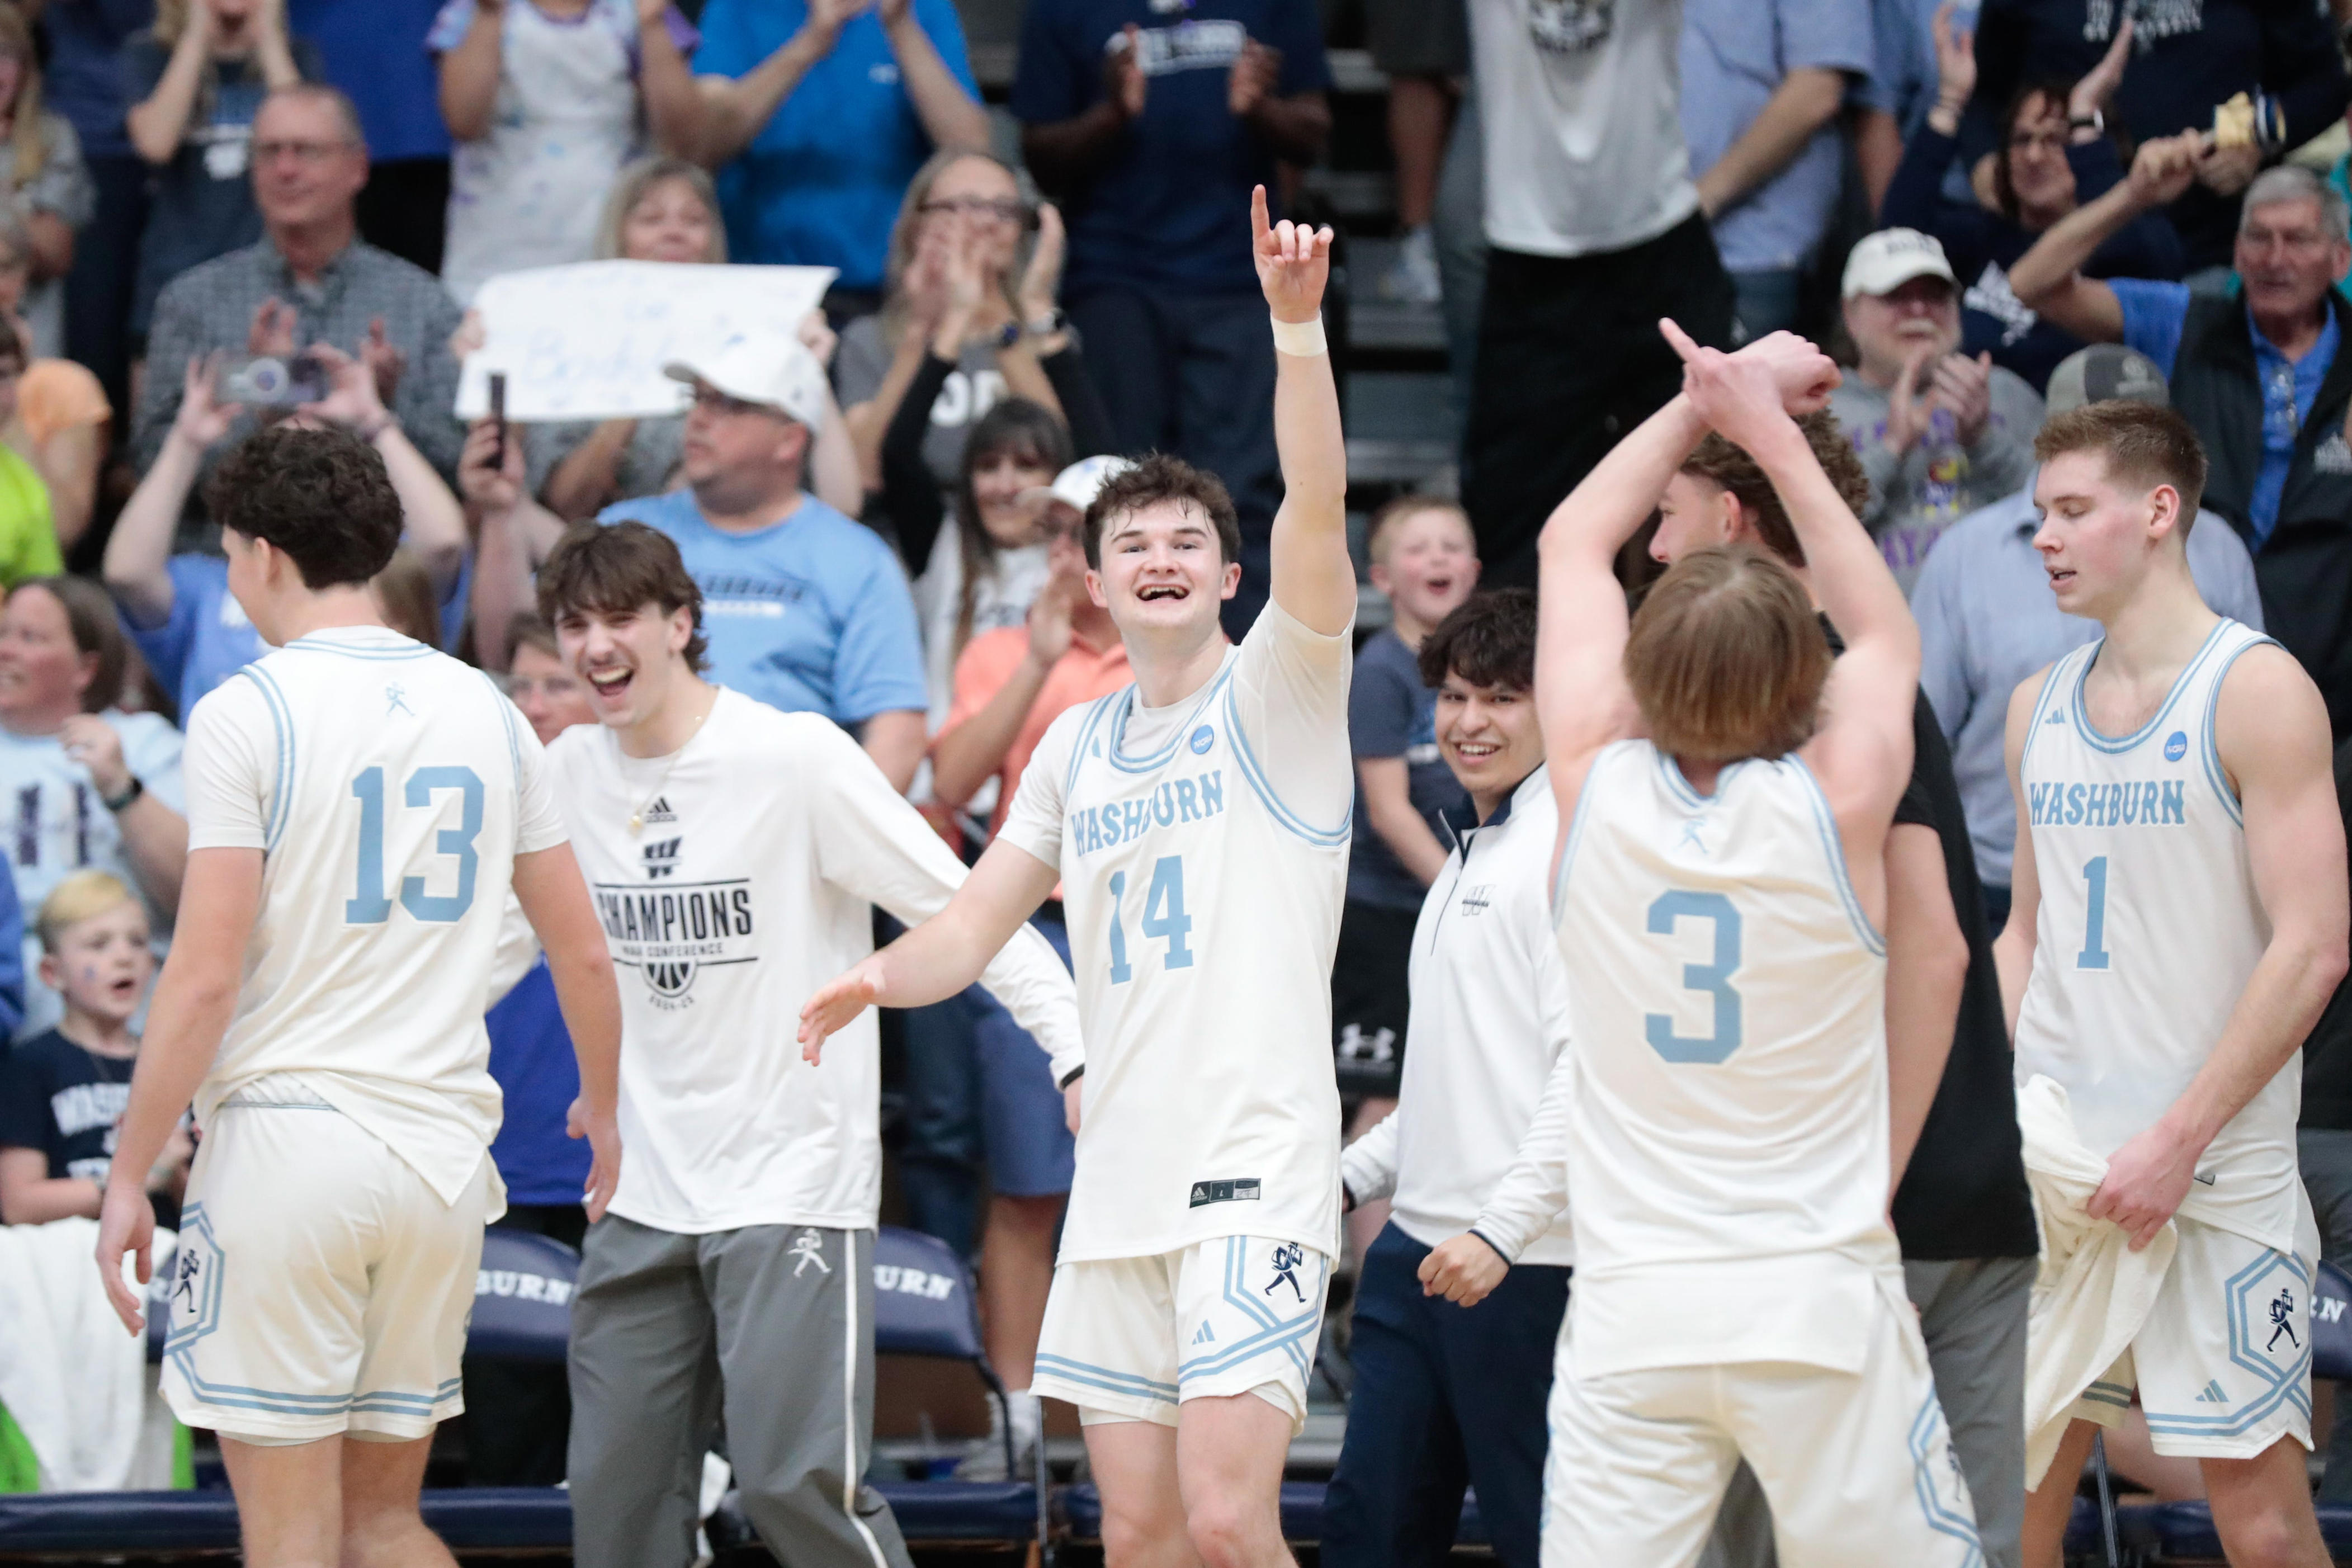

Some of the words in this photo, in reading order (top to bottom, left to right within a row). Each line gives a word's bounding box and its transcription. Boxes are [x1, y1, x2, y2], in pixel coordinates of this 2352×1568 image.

[346, 766, 484, 923] 13
[1071, 769, 1224, 857] WASHBURN
[2029, 780, 2185, 826] WASHBURN
[1109, 855, 1193, 985] 14
[2076, 856, 2109, 969] 1
[1645, 888, 1742, 1065] 3
